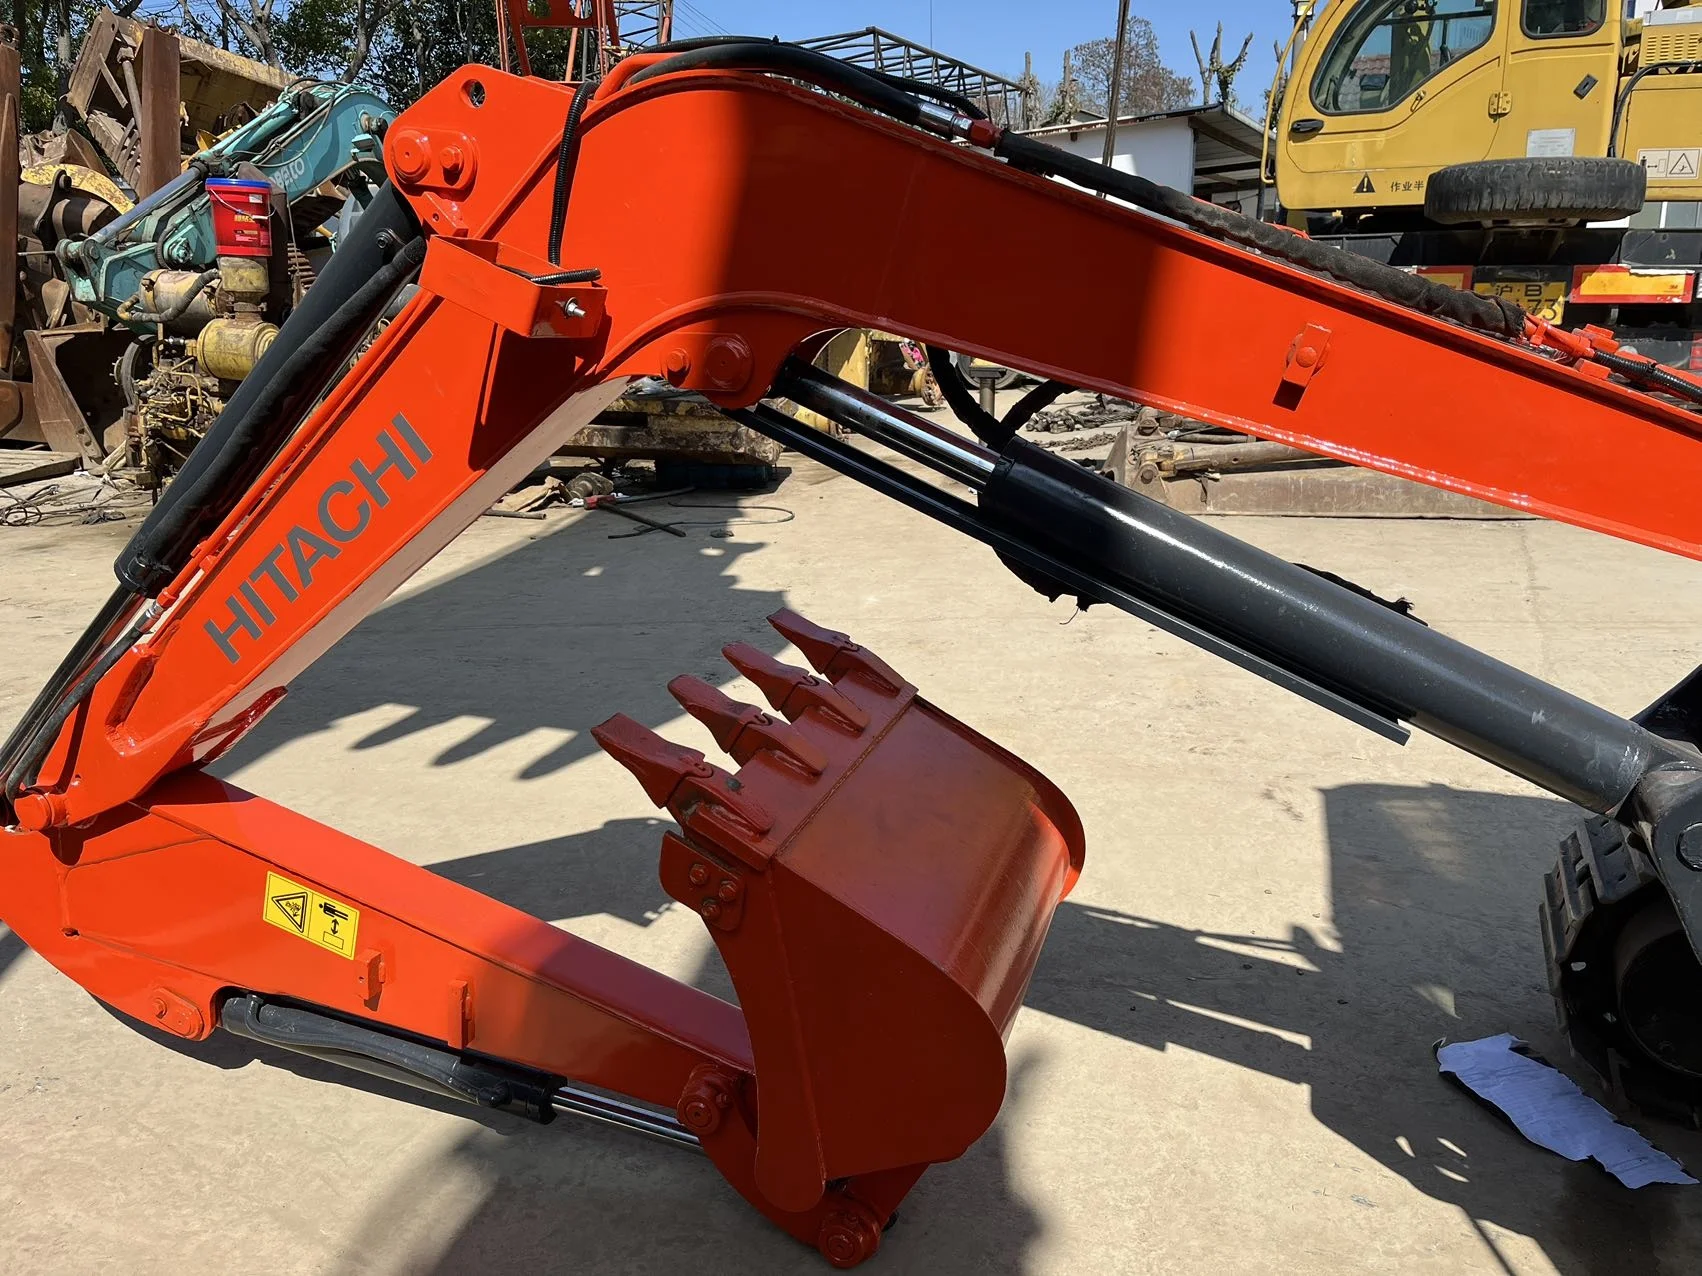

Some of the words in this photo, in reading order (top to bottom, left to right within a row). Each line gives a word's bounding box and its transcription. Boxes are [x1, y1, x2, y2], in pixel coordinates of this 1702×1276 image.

[1391, 180, 1424, 192] 作业半
[203, 411, 433, 665] HITACHI
